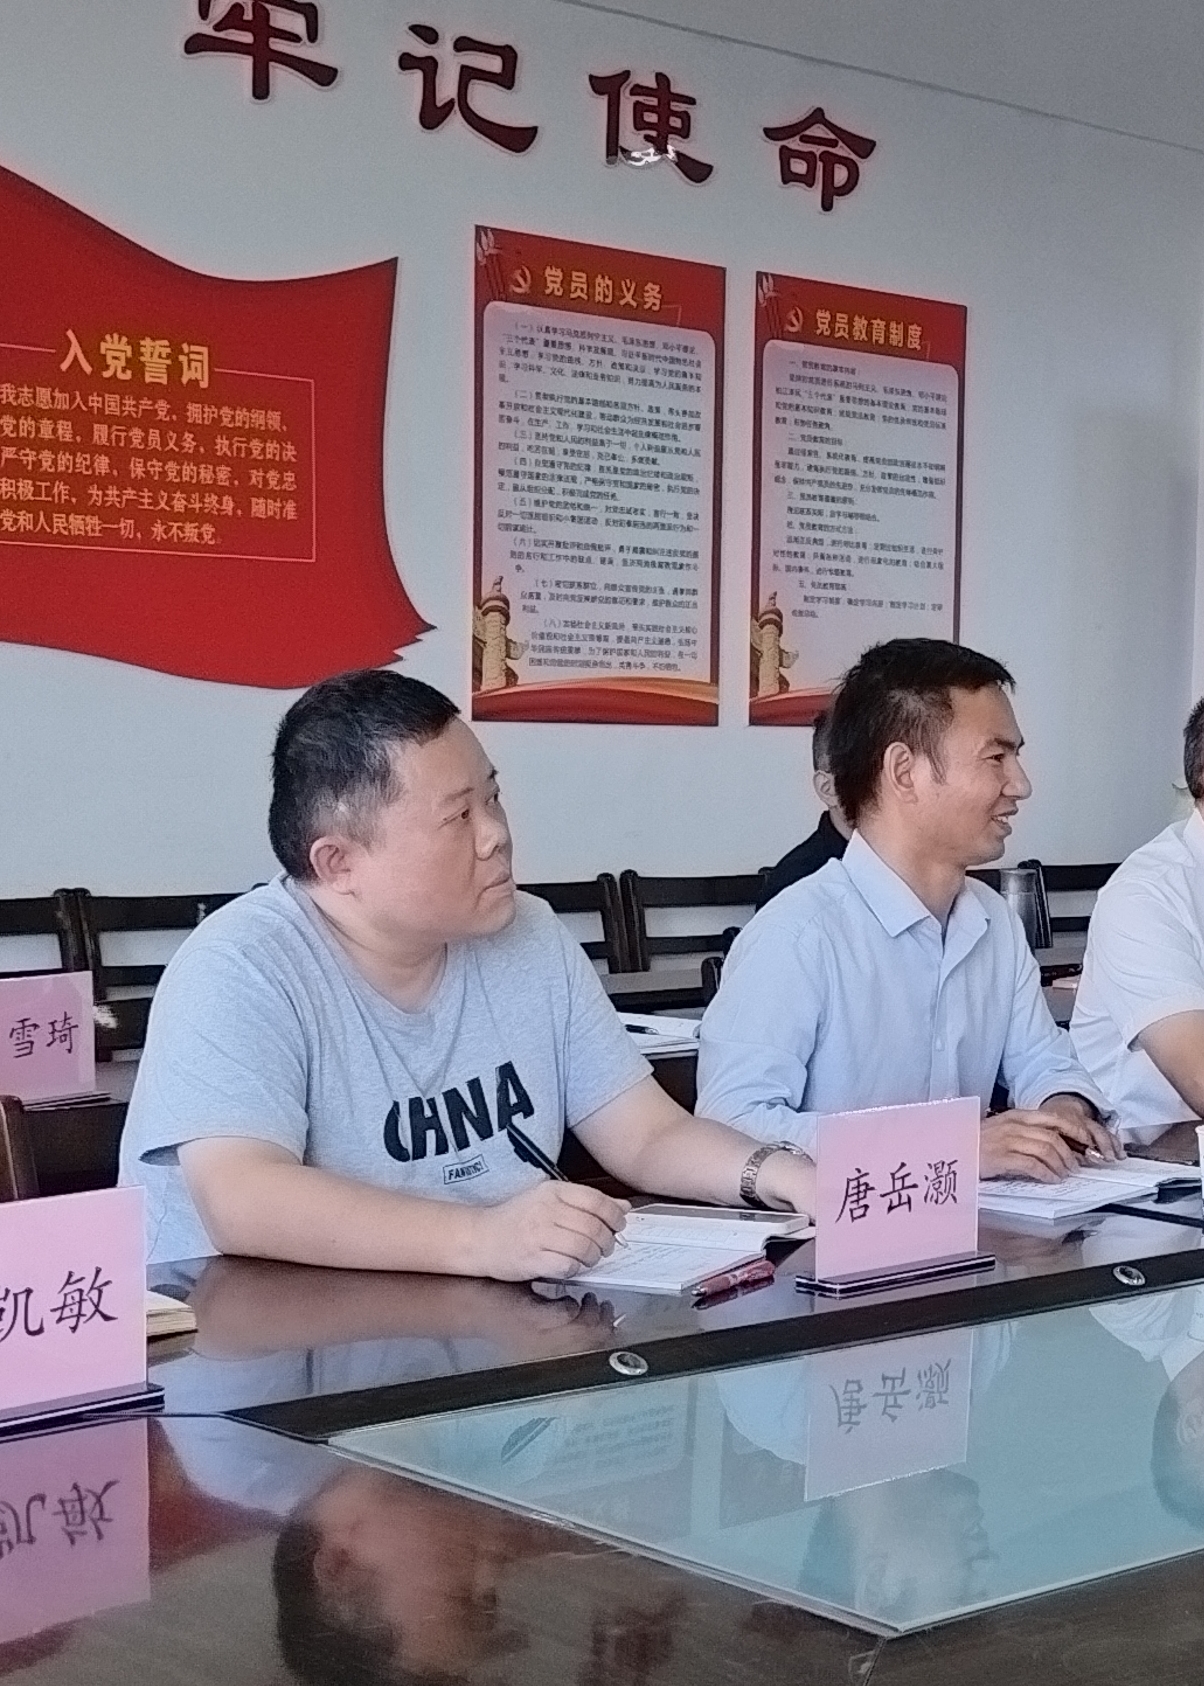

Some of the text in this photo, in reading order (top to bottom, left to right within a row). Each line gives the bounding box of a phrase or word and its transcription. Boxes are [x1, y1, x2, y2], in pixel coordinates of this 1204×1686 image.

[184, 0, 877, 211] 牢记使命
[544, 265, 662, 312] 党员的义务
[815, 308, 923, 351] 党员教育制度
[59, 328, 209, 389] 入党誓词
[9, 1011, 79, 1058] 雪琦
[835, 1159, 958, 1224] 唐岳灏
